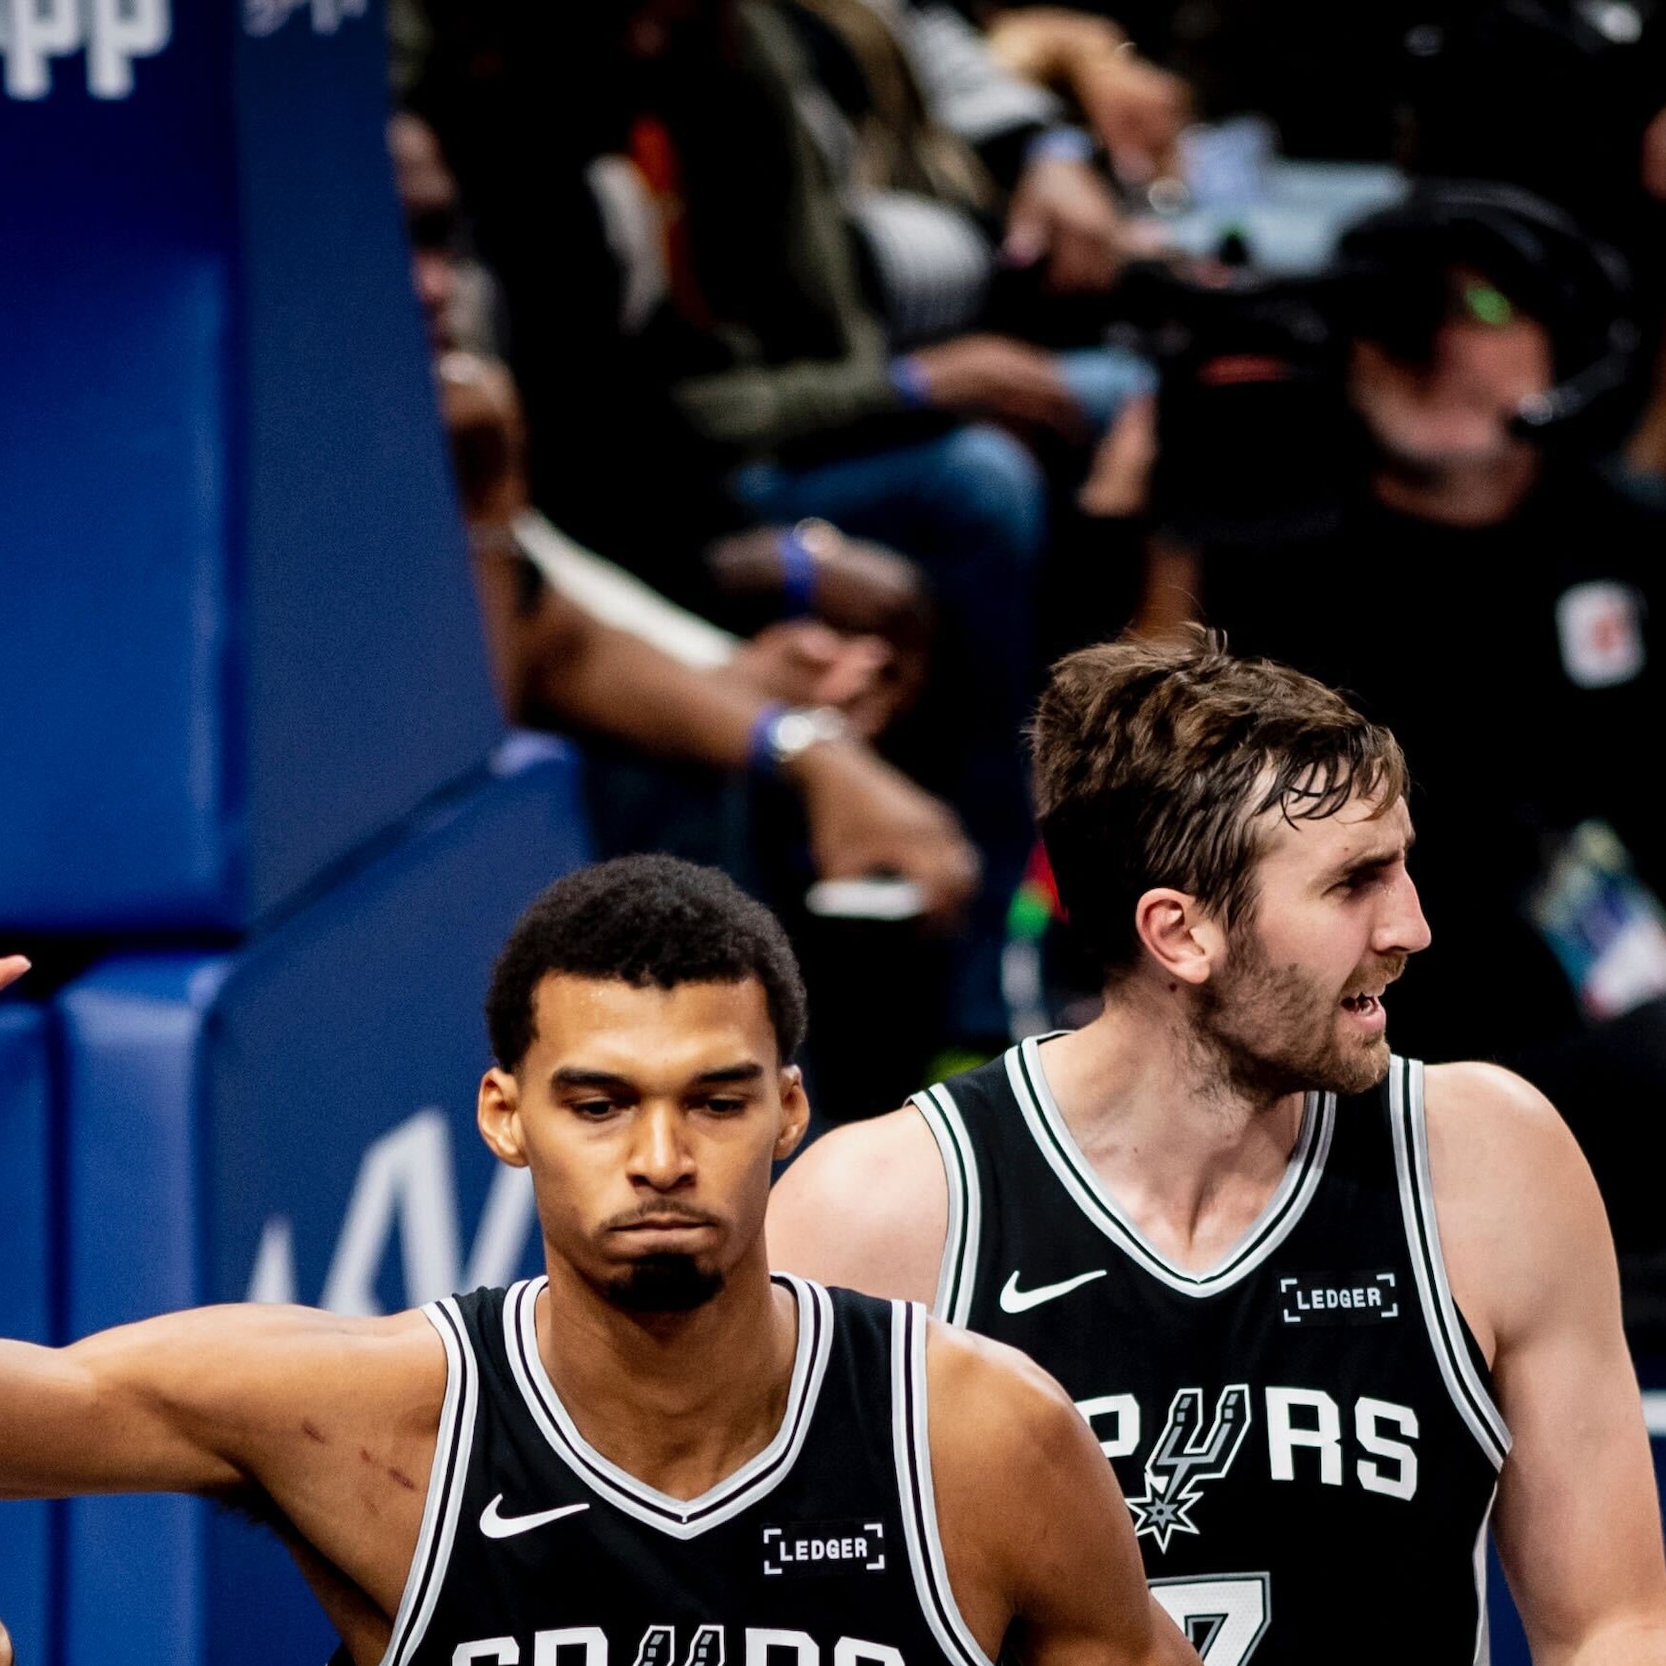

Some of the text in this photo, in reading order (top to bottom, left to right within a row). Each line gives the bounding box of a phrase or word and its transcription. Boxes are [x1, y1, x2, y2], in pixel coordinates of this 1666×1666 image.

[1296, 1286, 1382, 1311] LEDGER
[1075, 1383, 1419, 1555] PURS
[778, 1537, 869, 1563] LEDGER
